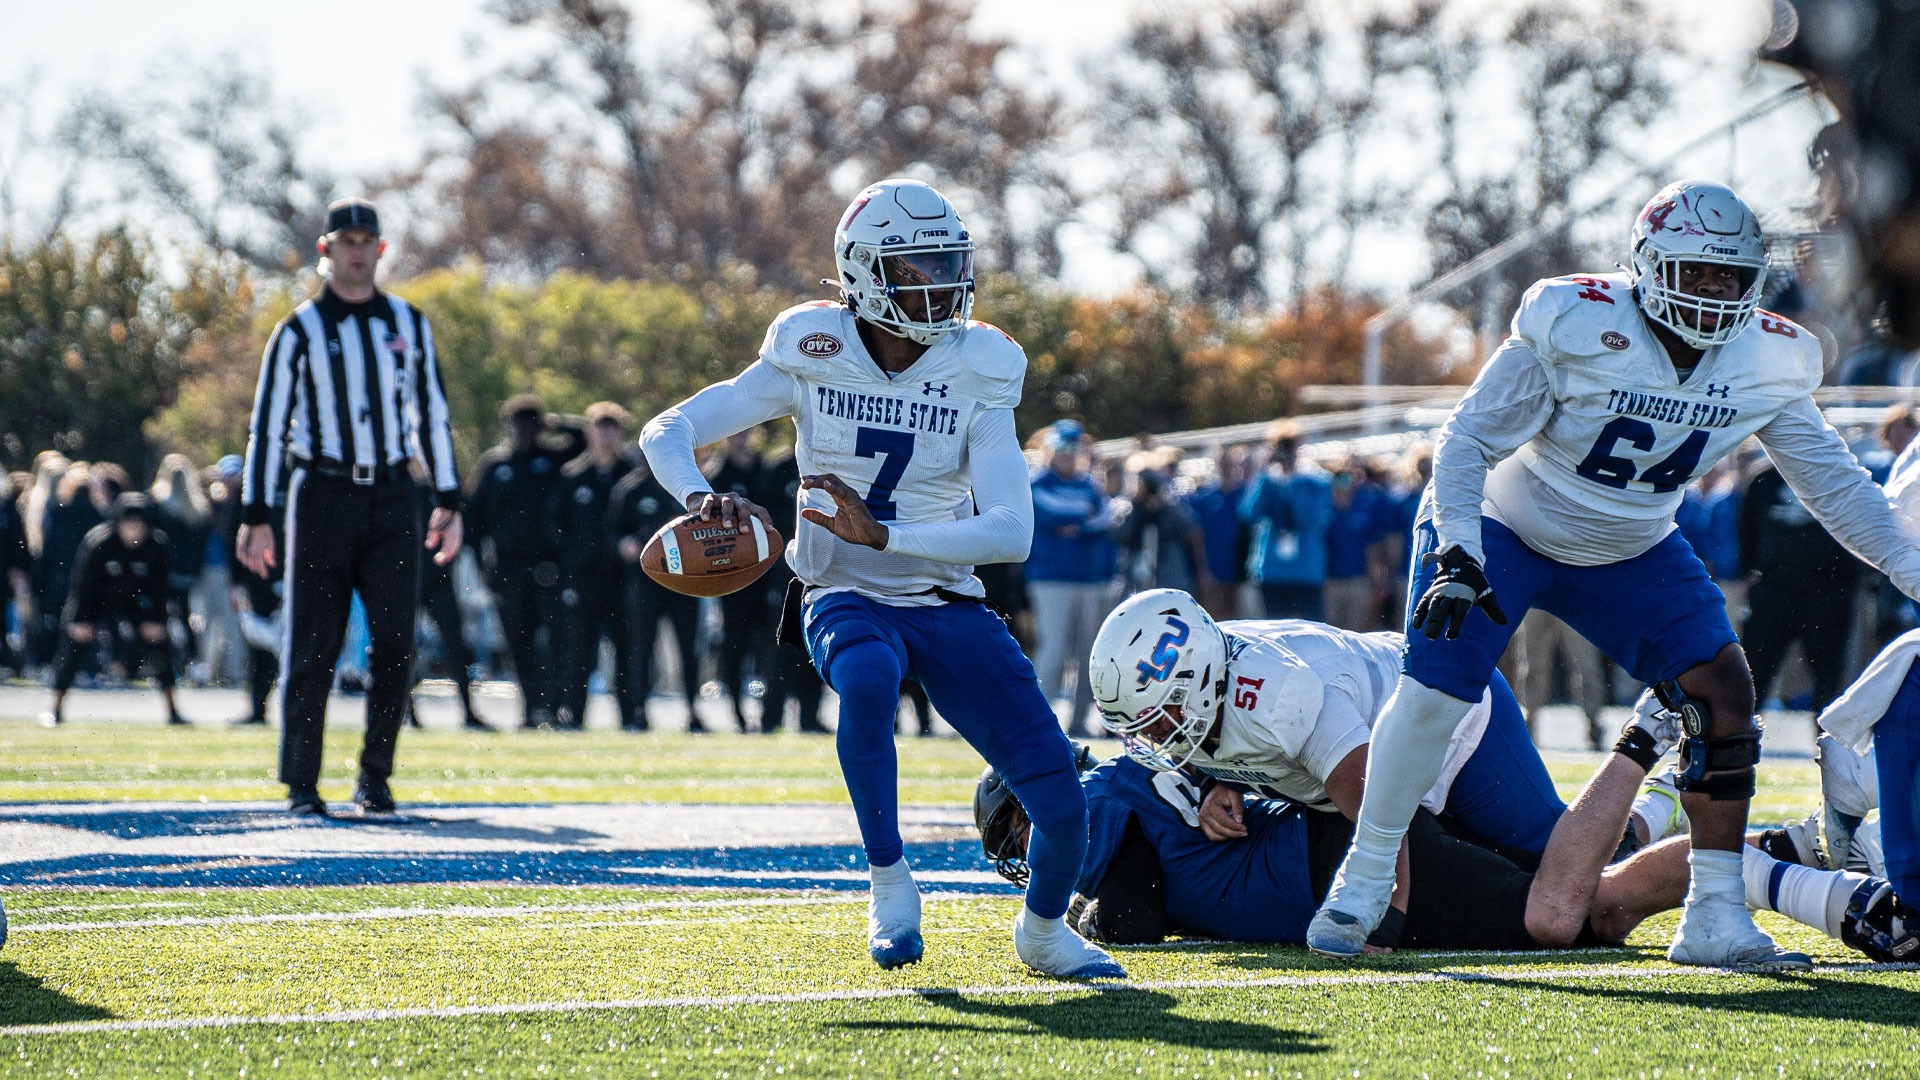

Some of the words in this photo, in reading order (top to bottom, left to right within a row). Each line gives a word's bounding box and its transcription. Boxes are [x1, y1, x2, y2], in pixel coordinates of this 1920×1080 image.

[921, 229, 949, 238] TIGERS
[1710, 245, 1739, 256] TIGERS
[1571, 277, 1616, 306] 64
[1757, 310, 1799, 340] 6
[806, 340, 833, 352] OVC
[1606, 335, 1624, 346] OVC
[817, 386, 904, 426] TENNESSEE
[908, 402, 959, 435] STATE
[1606, 388, 1688, 424] TENNESSEE
[1687, 403, 1738, 428] STATE
[1575, 416, 1711, 494] 64
[854, 426, 916, 521] 7
[692, 527, 739, 541] Wilson
[712, 558, 731, 567] NCAA
[1233, 675, 1267, 712] 51
